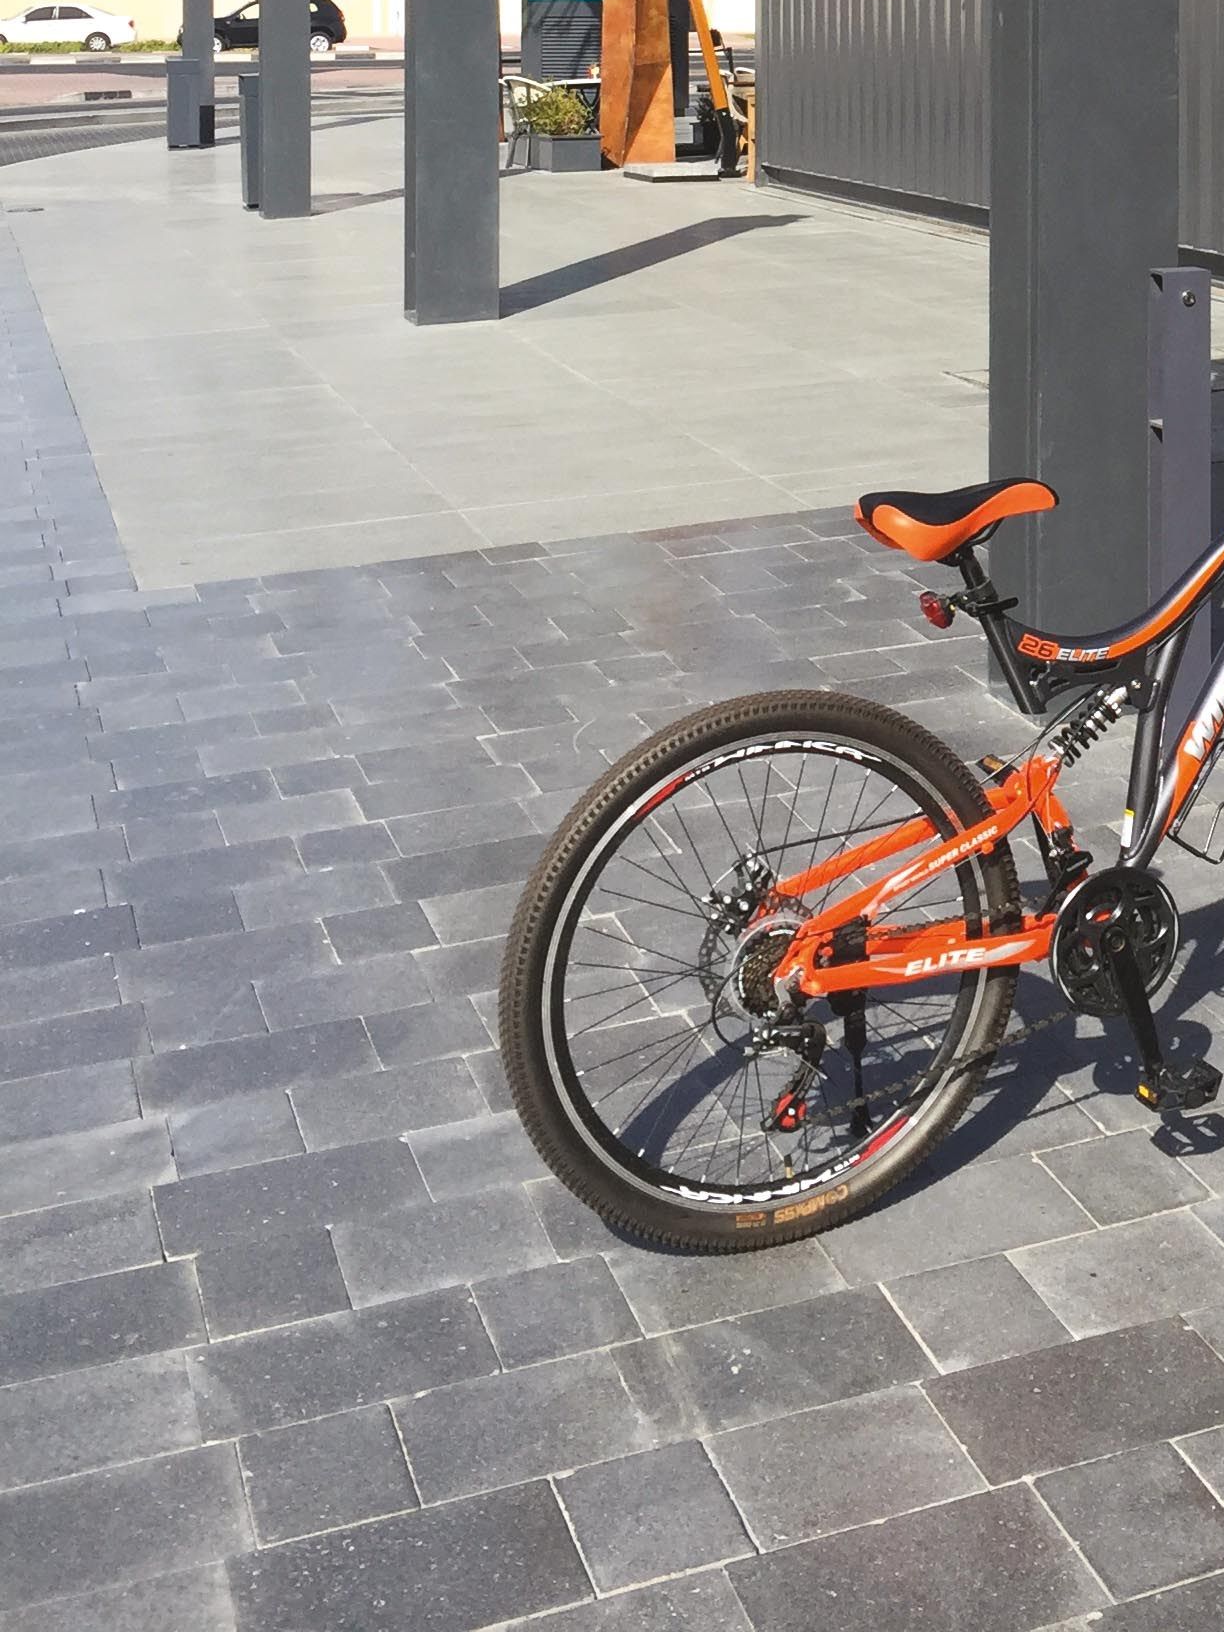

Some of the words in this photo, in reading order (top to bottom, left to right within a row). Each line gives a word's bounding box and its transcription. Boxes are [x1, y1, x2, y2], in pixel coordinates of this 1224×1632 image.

[1055, 647, 1110, 662] ELITE
[928, 848, 959, 870] SUPER
[960, 825, 998, 853] CLASSIC
[904, 947, 986, 976] ELITE
